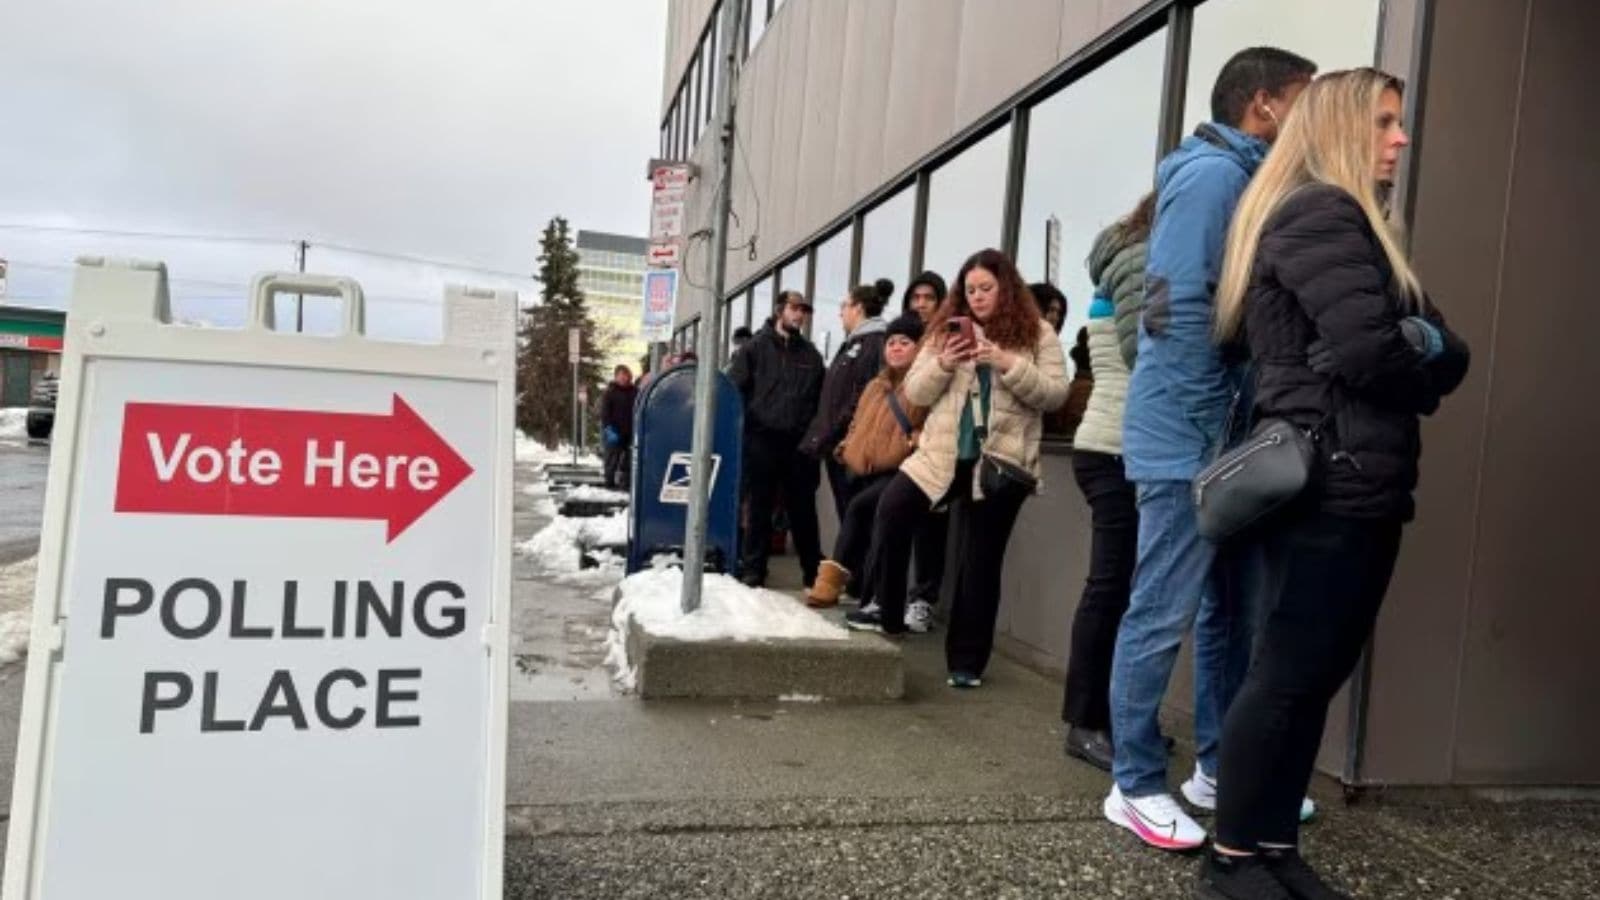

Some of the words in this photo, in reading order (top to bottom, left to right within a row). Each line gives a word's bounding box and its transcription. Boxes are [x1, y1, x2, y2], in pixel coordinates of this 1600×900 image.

[147, 432, 282, 486] Vote
[304, 439, 441, 491] Here
[100, 577, 467, 641] POLLING
[139, 668, 423, 734] PLACE
